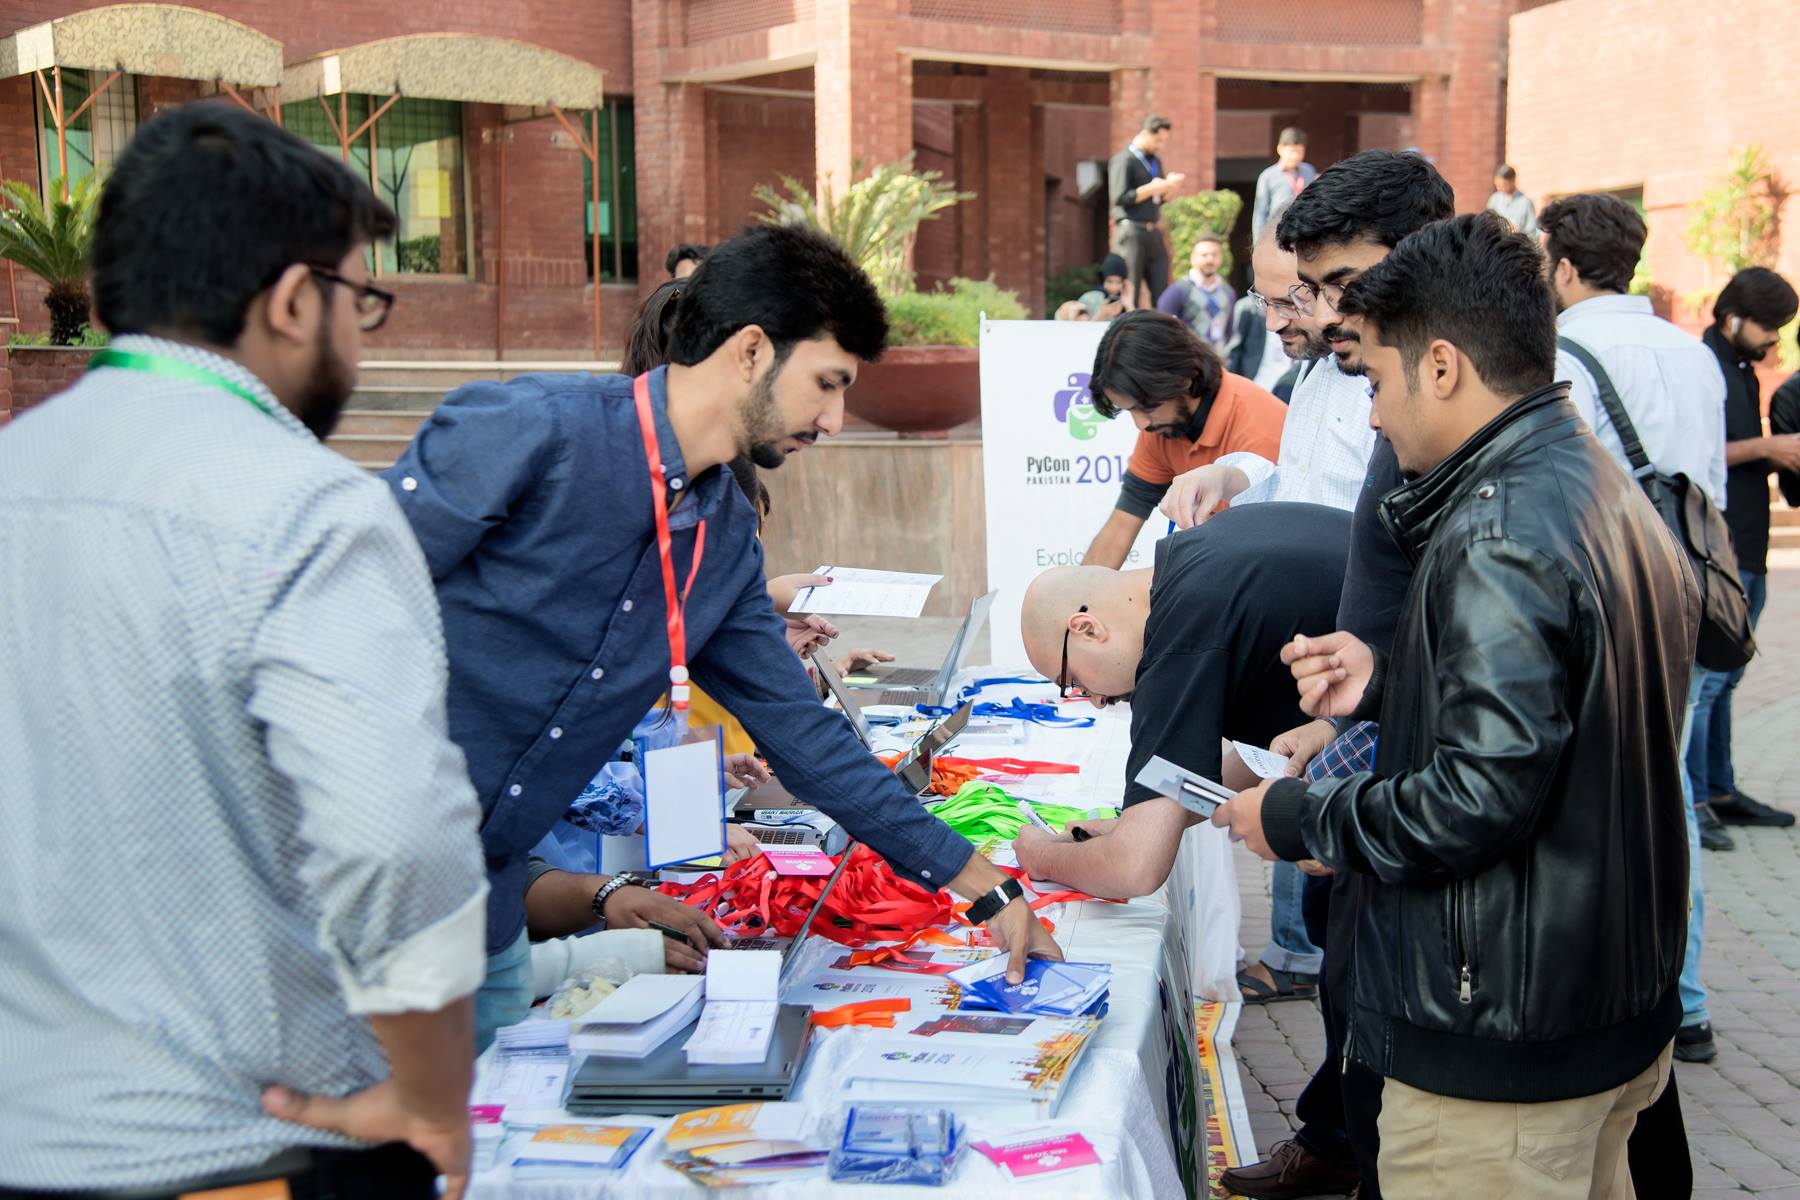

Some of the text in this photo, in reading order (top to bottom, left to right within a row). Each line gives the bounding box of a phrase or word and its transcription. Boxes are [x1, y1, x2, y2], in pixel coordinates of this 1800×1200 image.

[1026, 454, 1125, 484] PyCon 201
[1026, 476, 1071, 485] PAKISTAN
